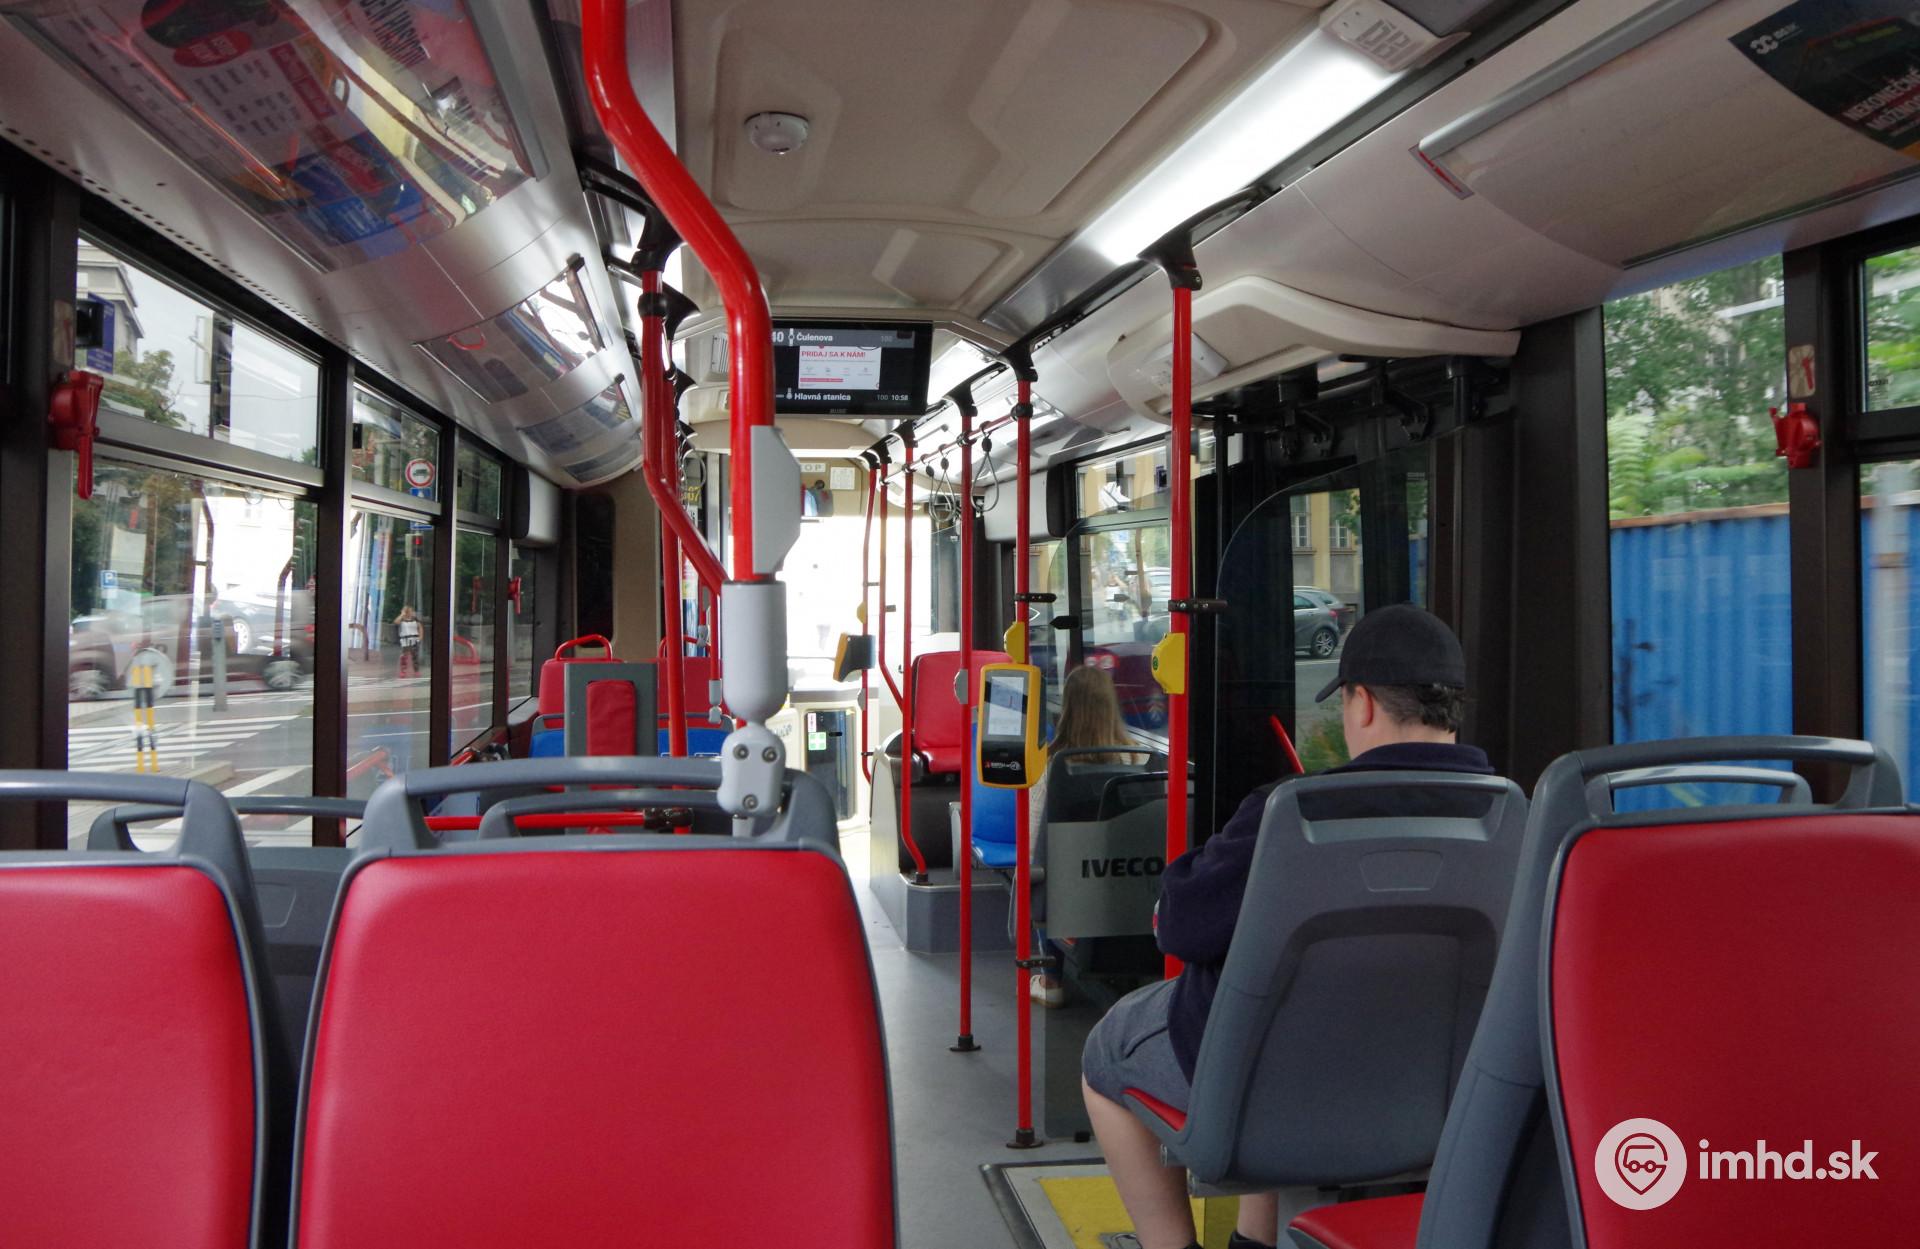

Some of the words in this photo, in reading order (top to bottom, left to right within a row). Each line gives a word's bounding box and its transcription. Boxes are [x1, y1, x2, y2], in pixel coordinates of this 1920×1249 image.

[796, 331, 833, 341] Čulenova
[794, 392, 821, 401] Hlavná
[823, 392, 851, 401] stanica
[1081, 857, 1164, 878] IVECO
